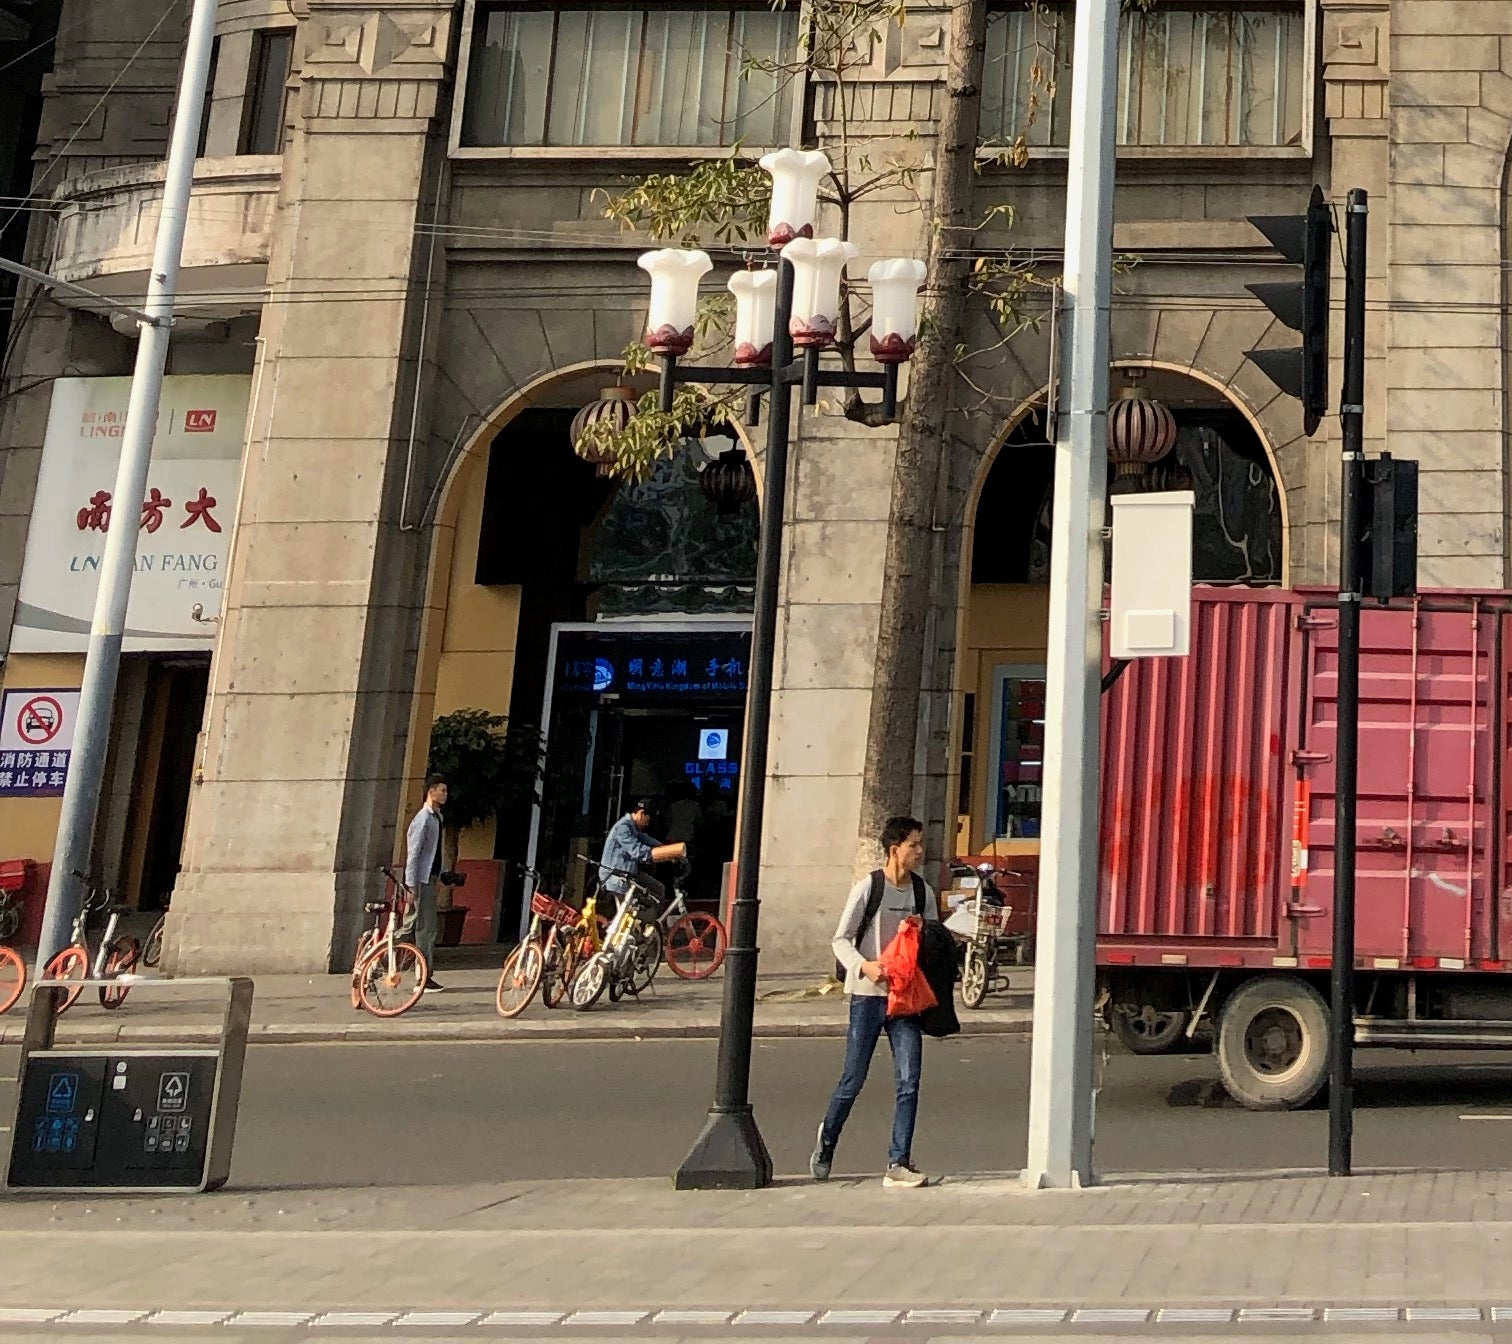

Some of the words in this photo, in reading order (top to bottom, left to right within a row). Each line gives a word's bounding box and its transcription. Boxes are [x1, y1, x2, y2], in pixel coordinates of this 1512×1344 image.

[189, 413, 213, 426] LN
[79, 425, 126, 438] LING
[161, 554, 219, 572] FANG
[0, 751, 67, 769] 消防通道
[0, 770, 65, 787] 禁止停车
